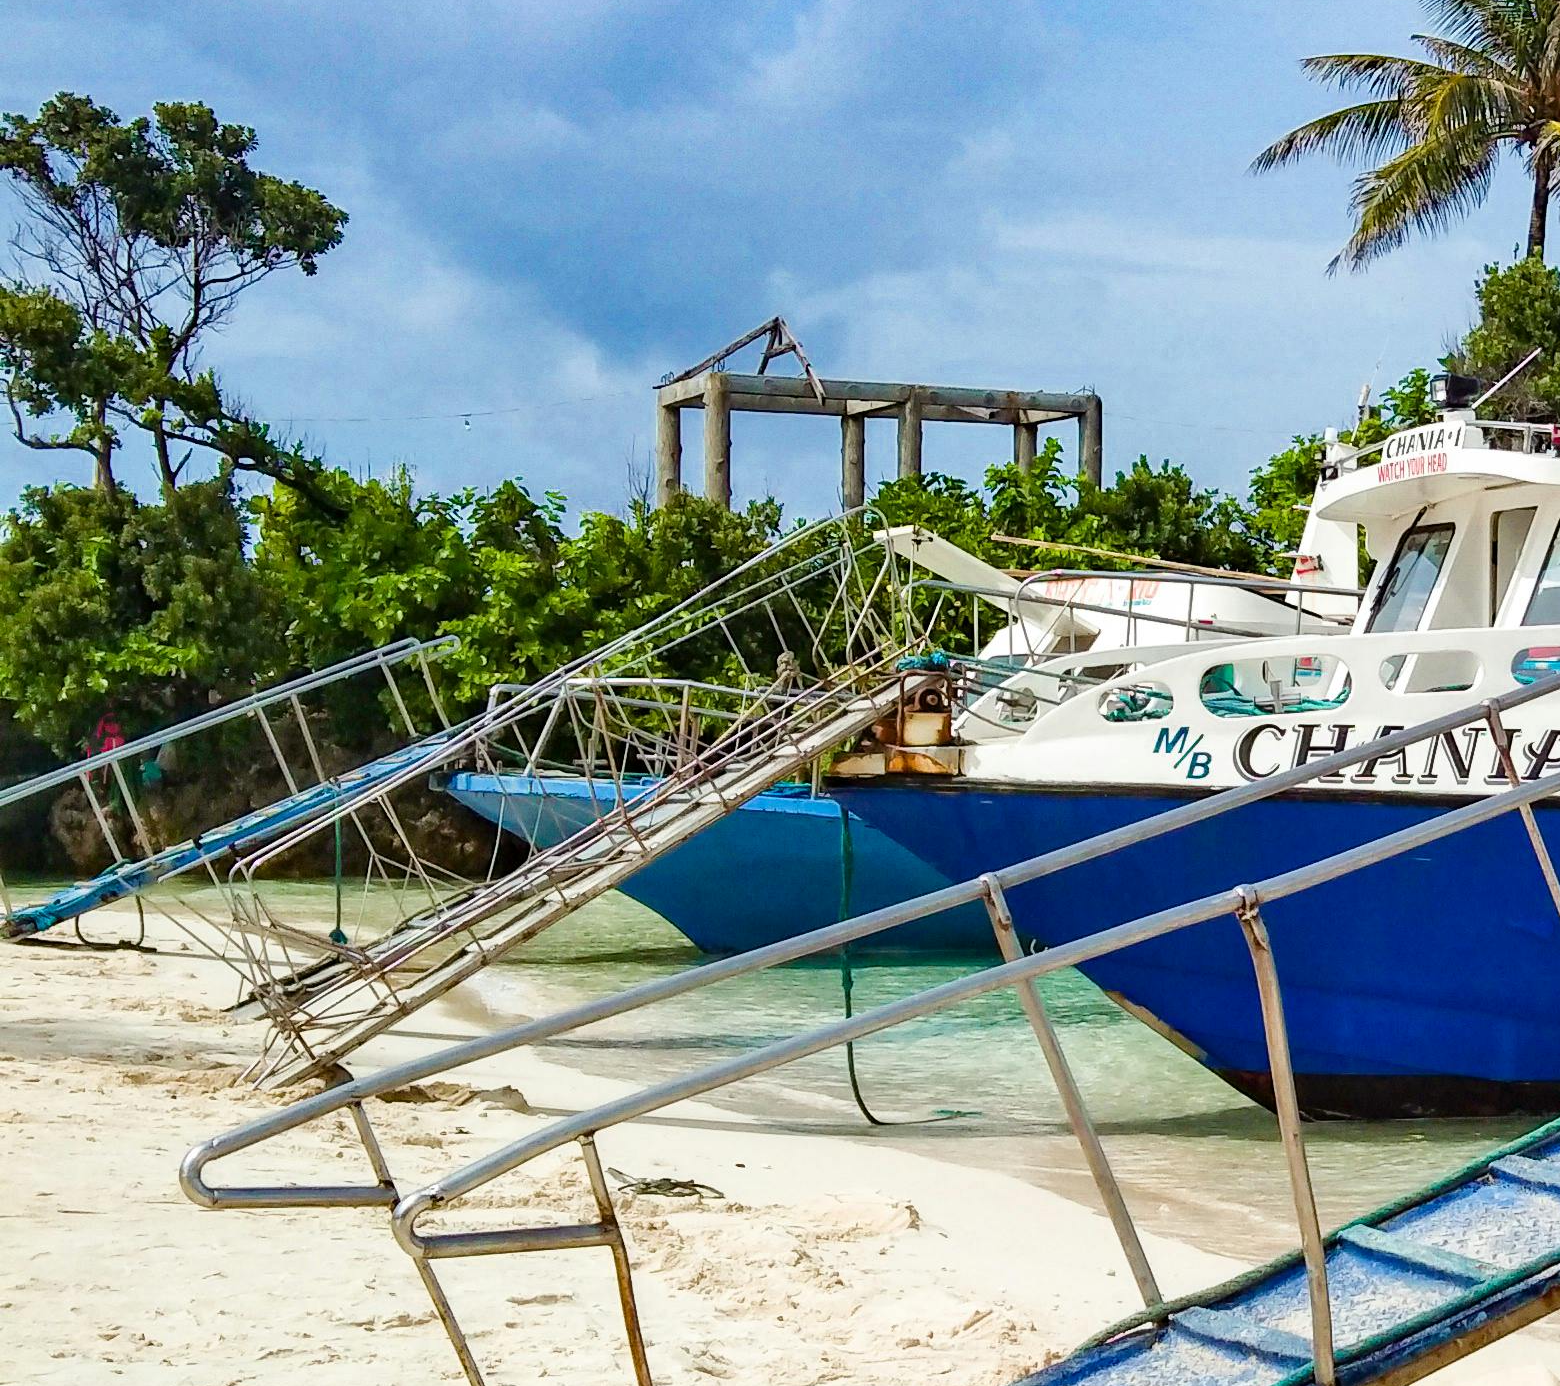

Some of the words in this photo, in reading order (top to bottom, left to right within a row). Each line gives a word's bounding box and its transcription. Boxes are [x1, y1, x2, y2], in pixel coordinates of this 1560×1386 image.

[1377, 460, 1405, 483] WATCH
[1406, 455, 1425, 477] YOUR
[1427, 452, 1448, 474] HEAD
[1153, 726, 1212, 780] M/B
